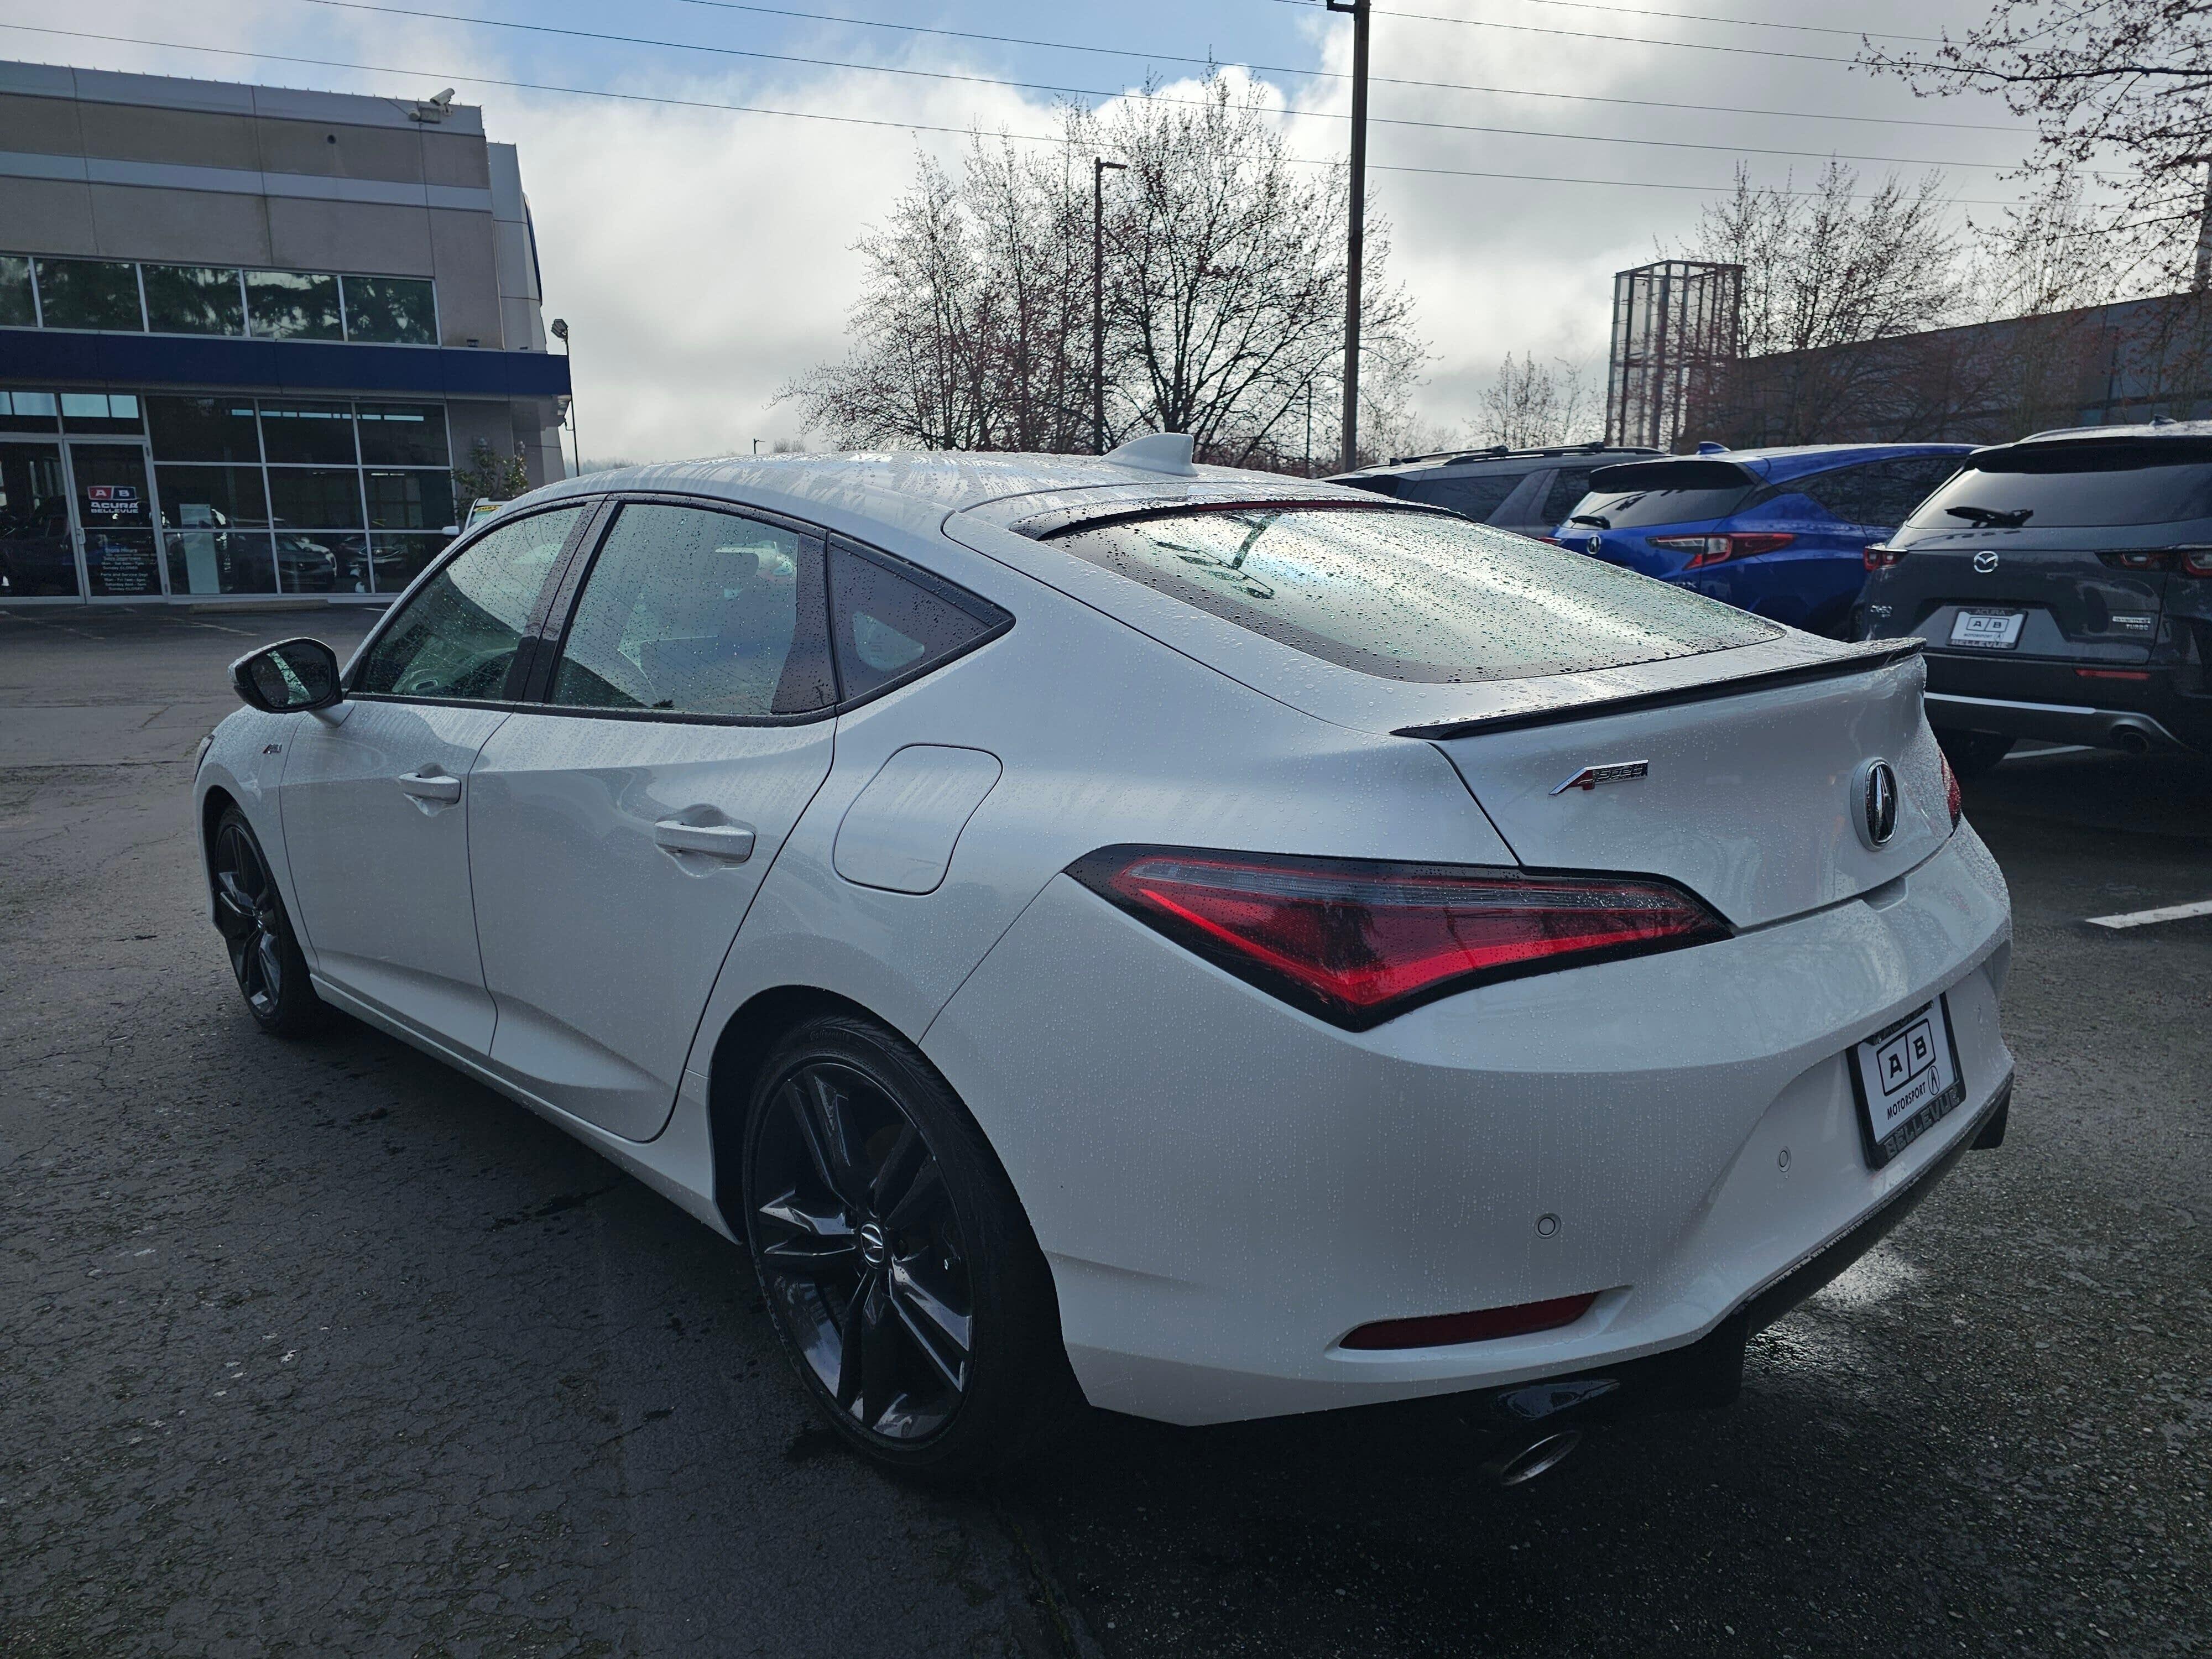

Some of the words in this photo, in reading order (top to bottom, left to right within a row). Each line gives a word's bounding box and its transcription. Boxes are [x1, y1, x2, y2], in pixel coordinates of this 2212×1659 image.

[1951, 639, 2008, 648] BELLEVUE
[1888, 1053, 1903, 1079] A
[1912, 1035, 1927, 1060] B
[1887, 1081, 1926, 1120] MOTORSPORT
[1884, 1086, 1960, 1160] BELLEVUE
